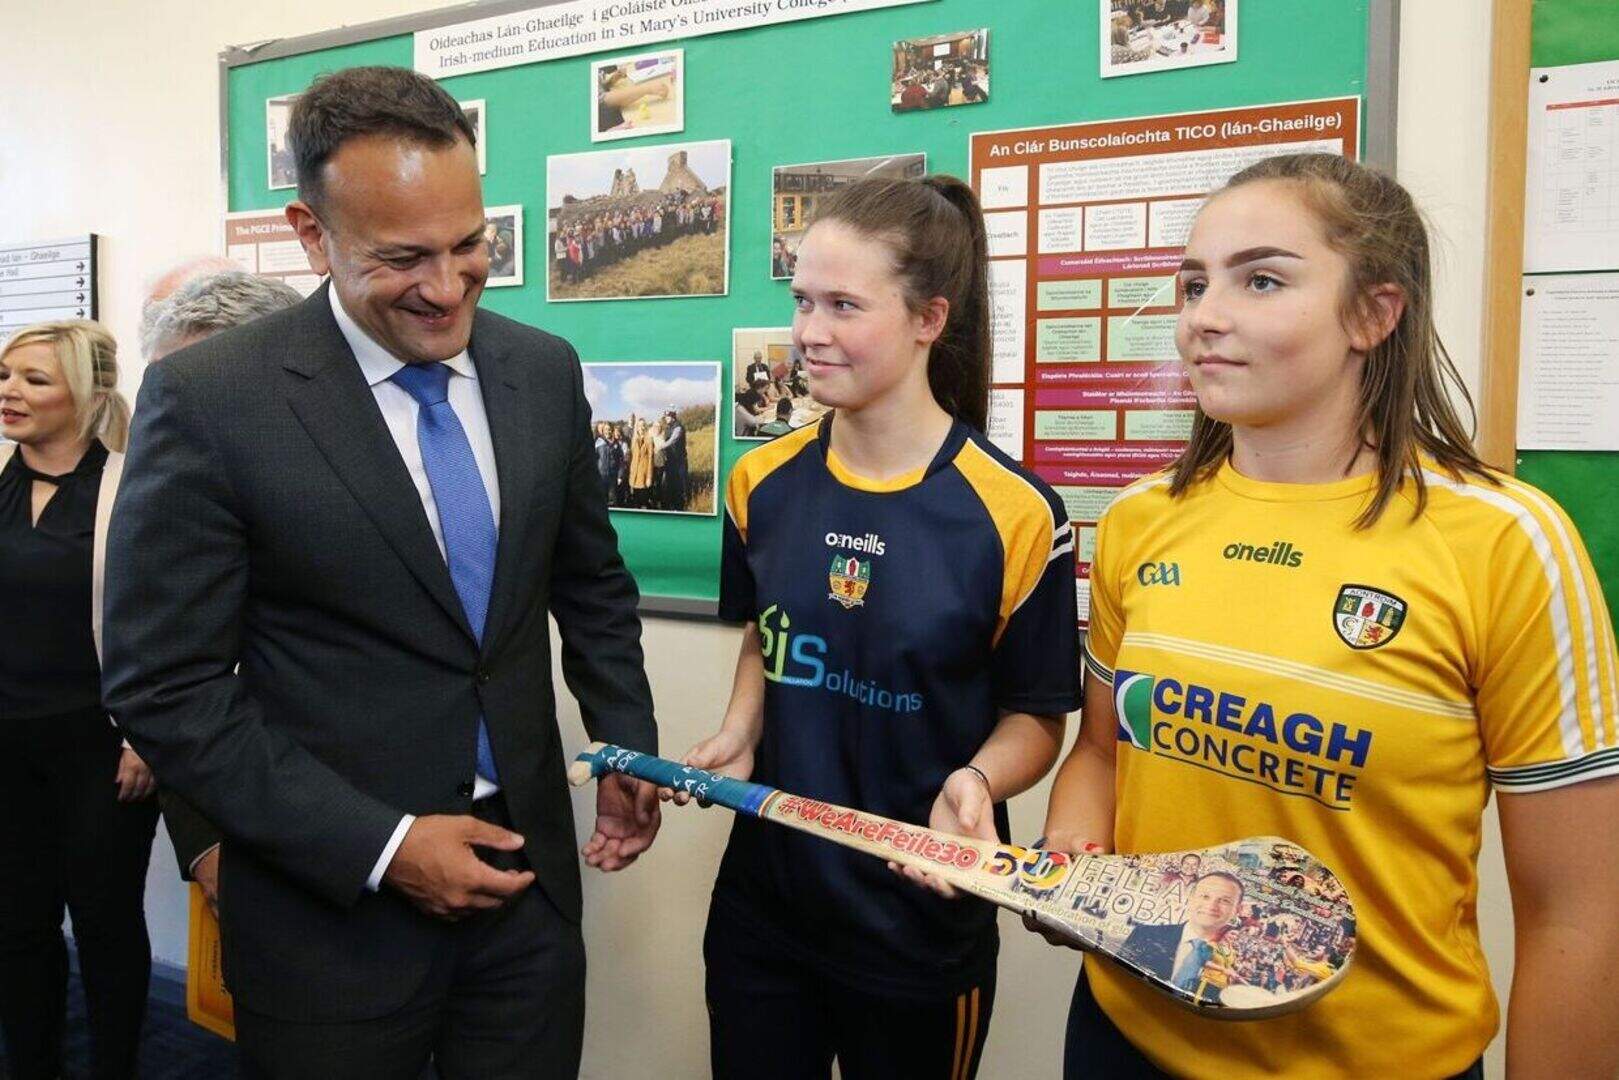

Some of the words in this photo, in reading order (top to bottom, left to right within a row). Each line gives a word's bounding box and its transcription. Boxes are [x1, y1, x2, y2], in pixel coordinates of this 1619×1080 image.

[430, 29, 493, 51] Oideachas
[497, 13, 584, 39] Lán-Ghaeilge
[439, 43, 524, 68] Irish-medium
[528, 30, 597, 51] Education
[602, 27, 615, 39] in
[620, 22, 635, 37] St
[640, 15, 688, 34] Mary's
[693, 2, 770, 26] University
[989, 144, 1010, 157] An
[1014, 140, 1045, 155] Clár
[1049, 129, 1171, 153] Bunscolaíochta
[1175, 124, 1216, 140] TICO
[1221, 112, 1342, 139] (lán-Ghaeilge)
[1153, 678, 1372, 768] CREAGH
[1153, 721, 1357, 802] CONCRETE
